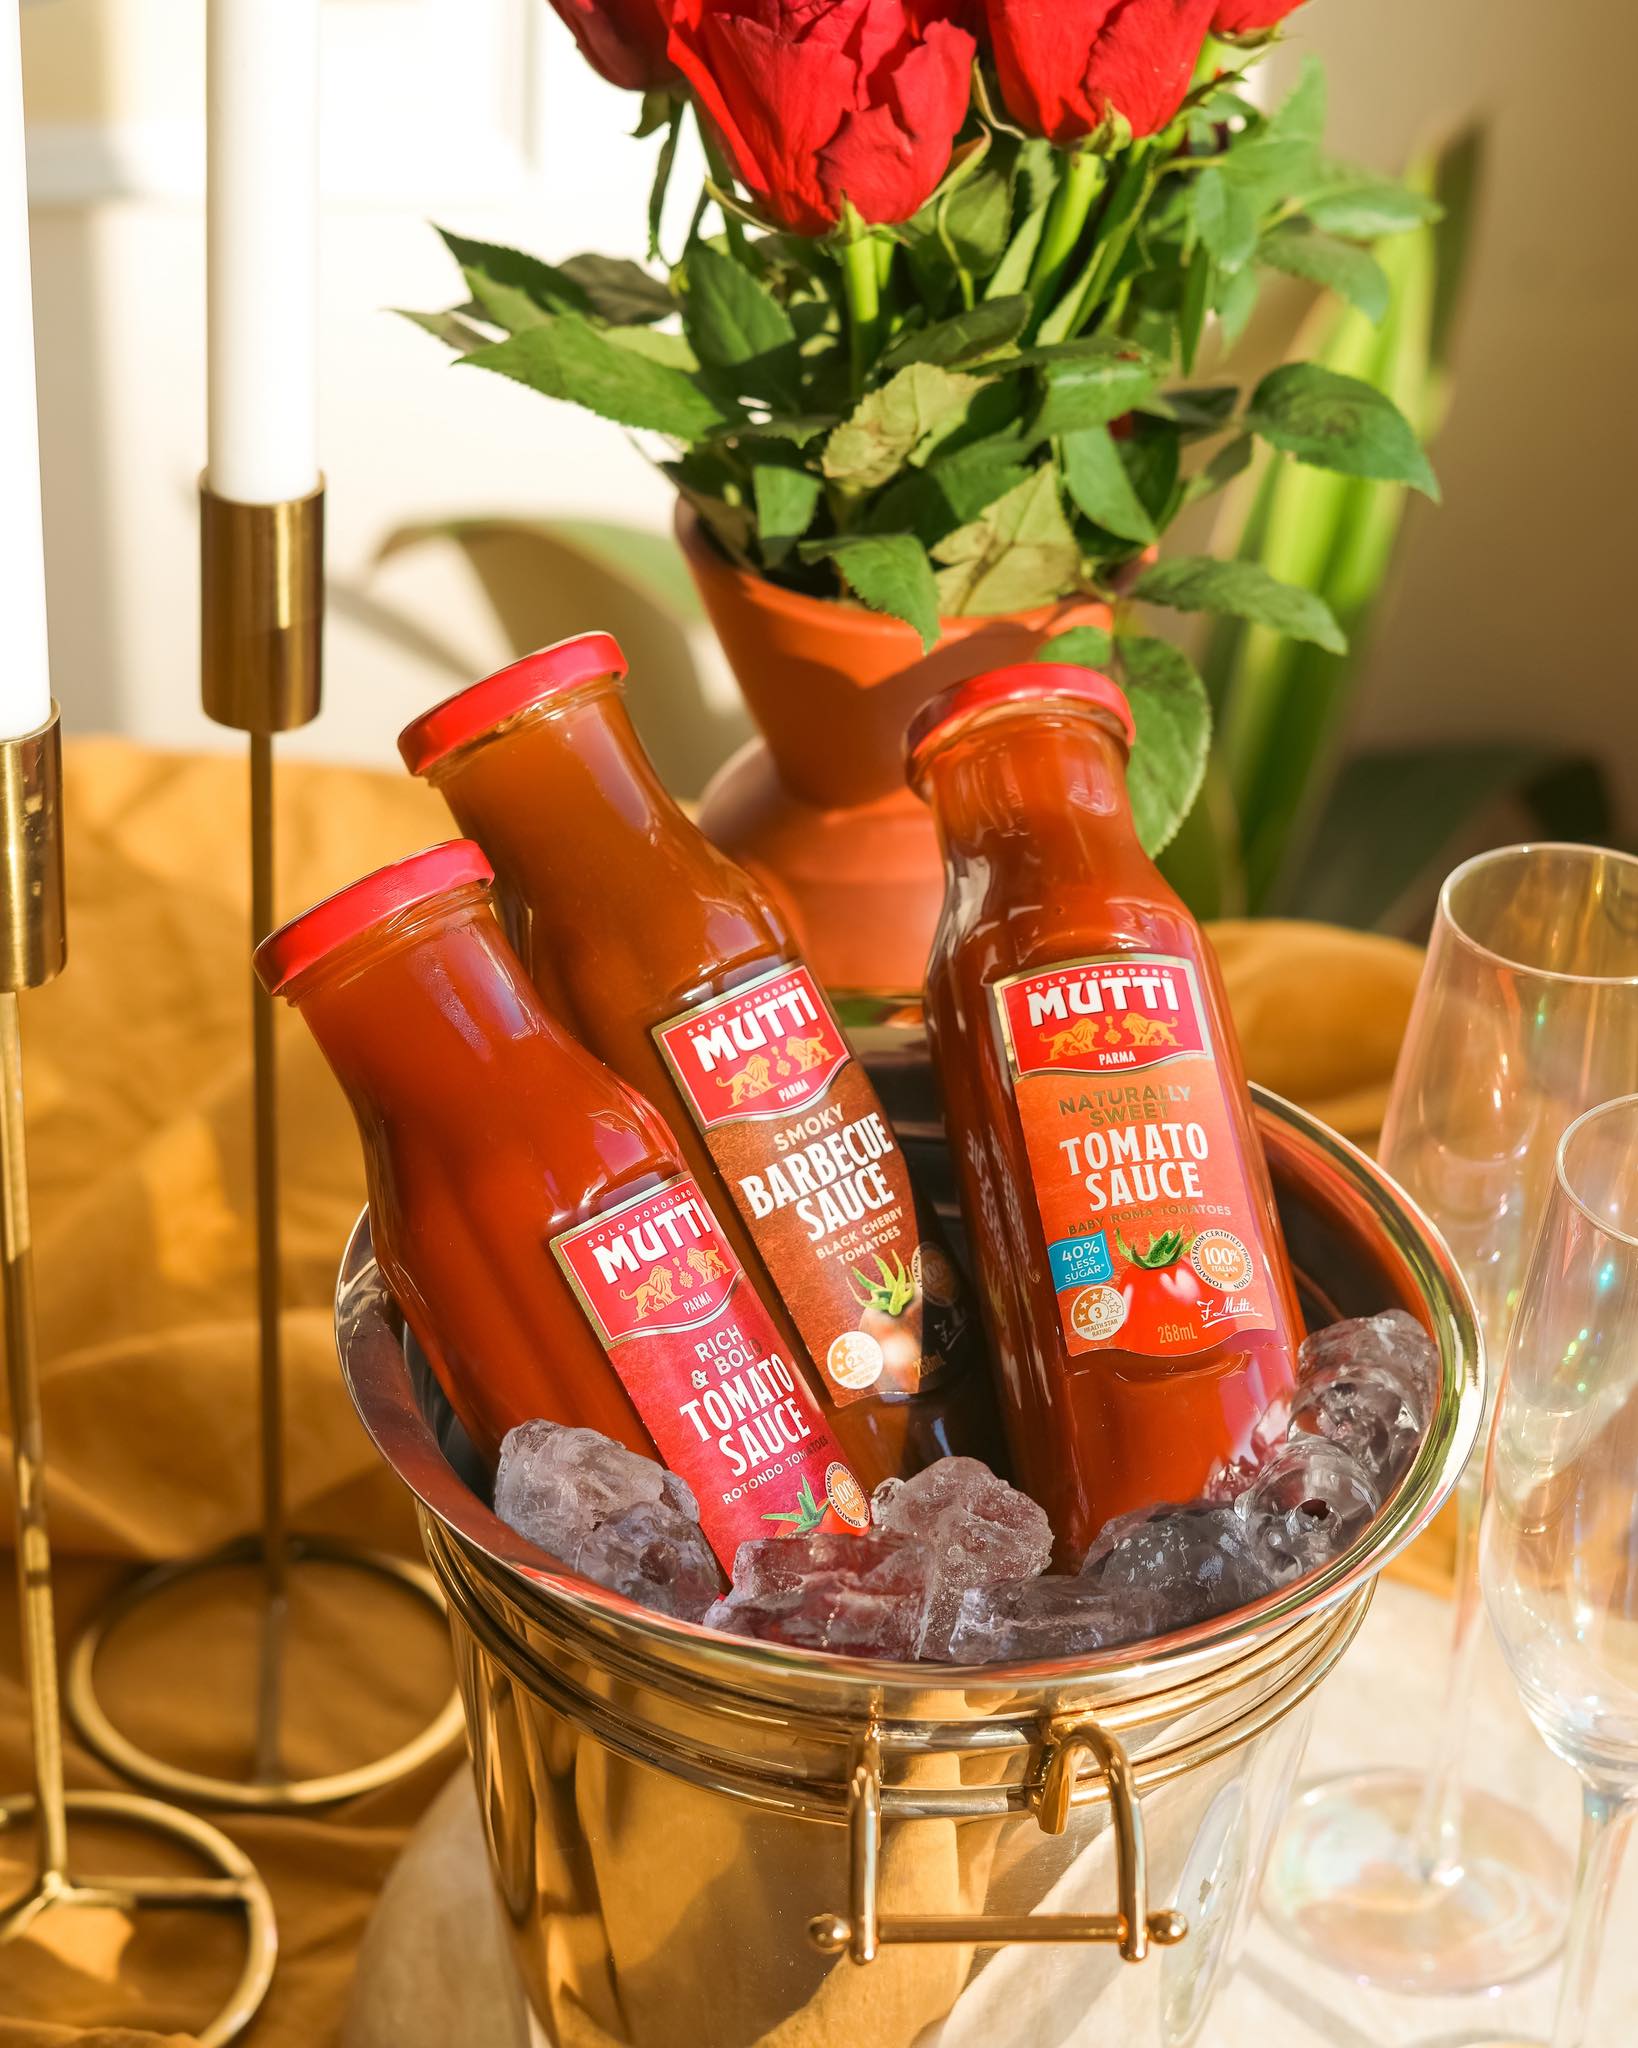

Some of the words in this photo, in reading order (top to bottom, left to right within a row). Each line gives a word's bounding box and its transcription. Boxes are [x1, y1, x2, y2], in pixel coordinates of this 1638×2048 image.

[1025, 976, 1067, 993] SOLO
[1026, 976, 1180, 1027] MUTTI
[687, 1013, 726, 1037] SOLO
[691, 986, 819, 1073] MUTTI
[1098, 1050, 1136, 1066] PARMA
[778, 1079, 811, 1103] PARMA
[1058, 1086, 1191, 1115] NATURALLY
[774, 1103, 845, 1151] SMOKY
[1089, 1103, 1168, 1127] SWEET
[737, 1112, 894, 1220] BARBECUE
[1059, 1123, 1209, 1176] TOMATO
[796, 1162, 895, 1241] SAUCE
[1085, 1162, 1203, 1212] SAUCE
[587, 1223, 625, 1248] SOLO
[815, 1231, 859, 1260] BLACK
[861, 1206, 904, 1236] CHERRY
[1068, 1217, 1104, 1235] BABY
[1110, 1209, 1153, 1224] ROMA
[1160, 1204, 1232, 1216] TOMATOES
[591, 1198, 712, 1285] MUTTI
[837, 1226, 901, 1265] TOMATOES
[1062, 1240, 1100, 1262] 40%
[1204, 1247, 1241, 1265] 100%
[1070, 1257, 1096, 1272] LESS
[683, 1291, 713, 1315] PARMA
[1094, 1307, 1102, 1319] 3
[694, 1324, 744, 1363] RICH
[1157, 1322, 1198, 1344] 268mL
[690, 1369, 710, 1390] &
[714, 1339, 761, 1376] BOLD
[679, 1353, 795, 1443] TOMATO
[718, 1397, 811, 1477] SAUCE
[722, 1463, 783, 1505] ROTONDO
[785, 1435, 829, 1468] TOMATOES
